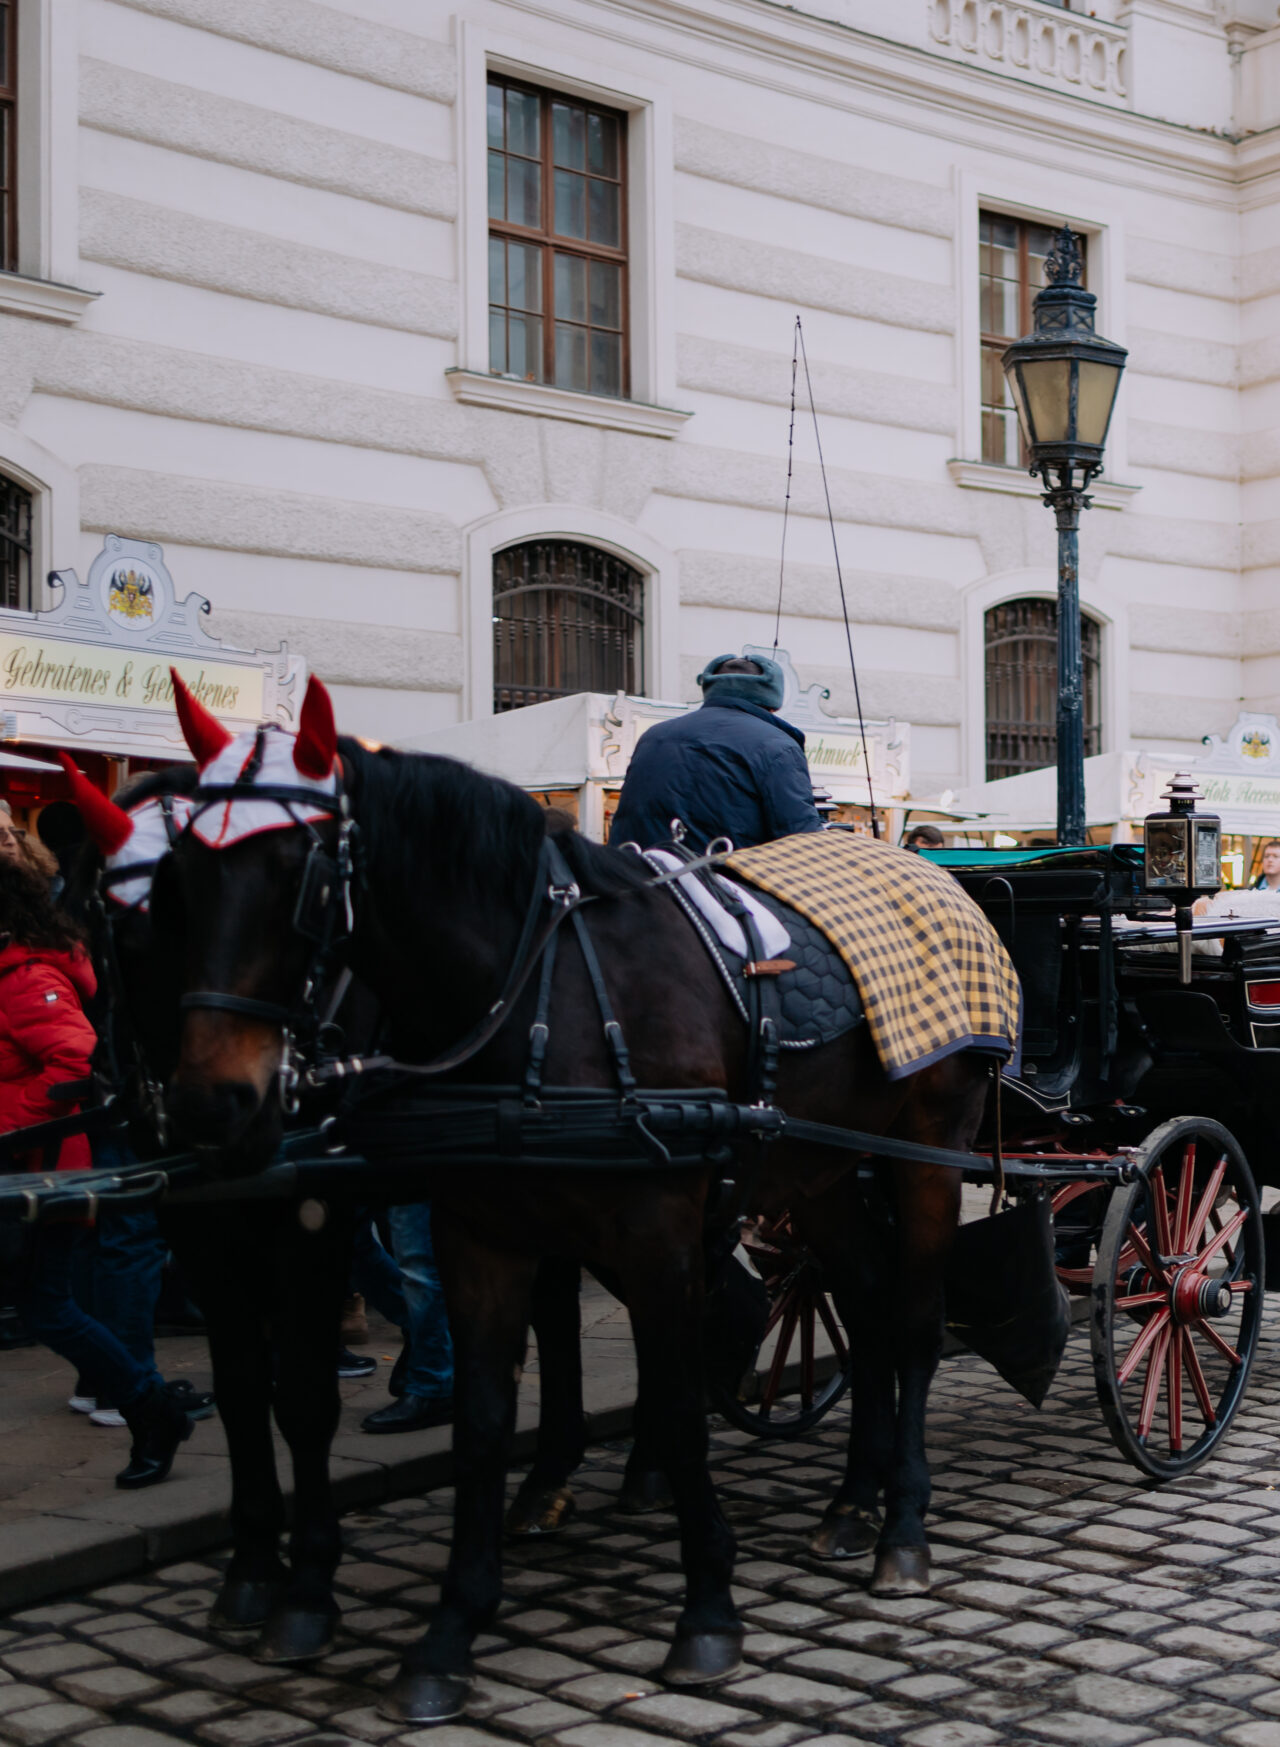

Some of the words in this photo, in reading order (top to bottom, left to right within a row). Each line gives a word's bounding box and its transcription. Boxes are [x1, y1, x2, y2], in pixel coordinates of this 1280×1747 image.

[3, 646, 111, 695] Gebratenes
[116, 661, 134, 698] &
[141, 664, 239, 709] Gebkenes
[805, 738, 861, 767] chmuck
[1200, 779, 1231, 802] Holz
